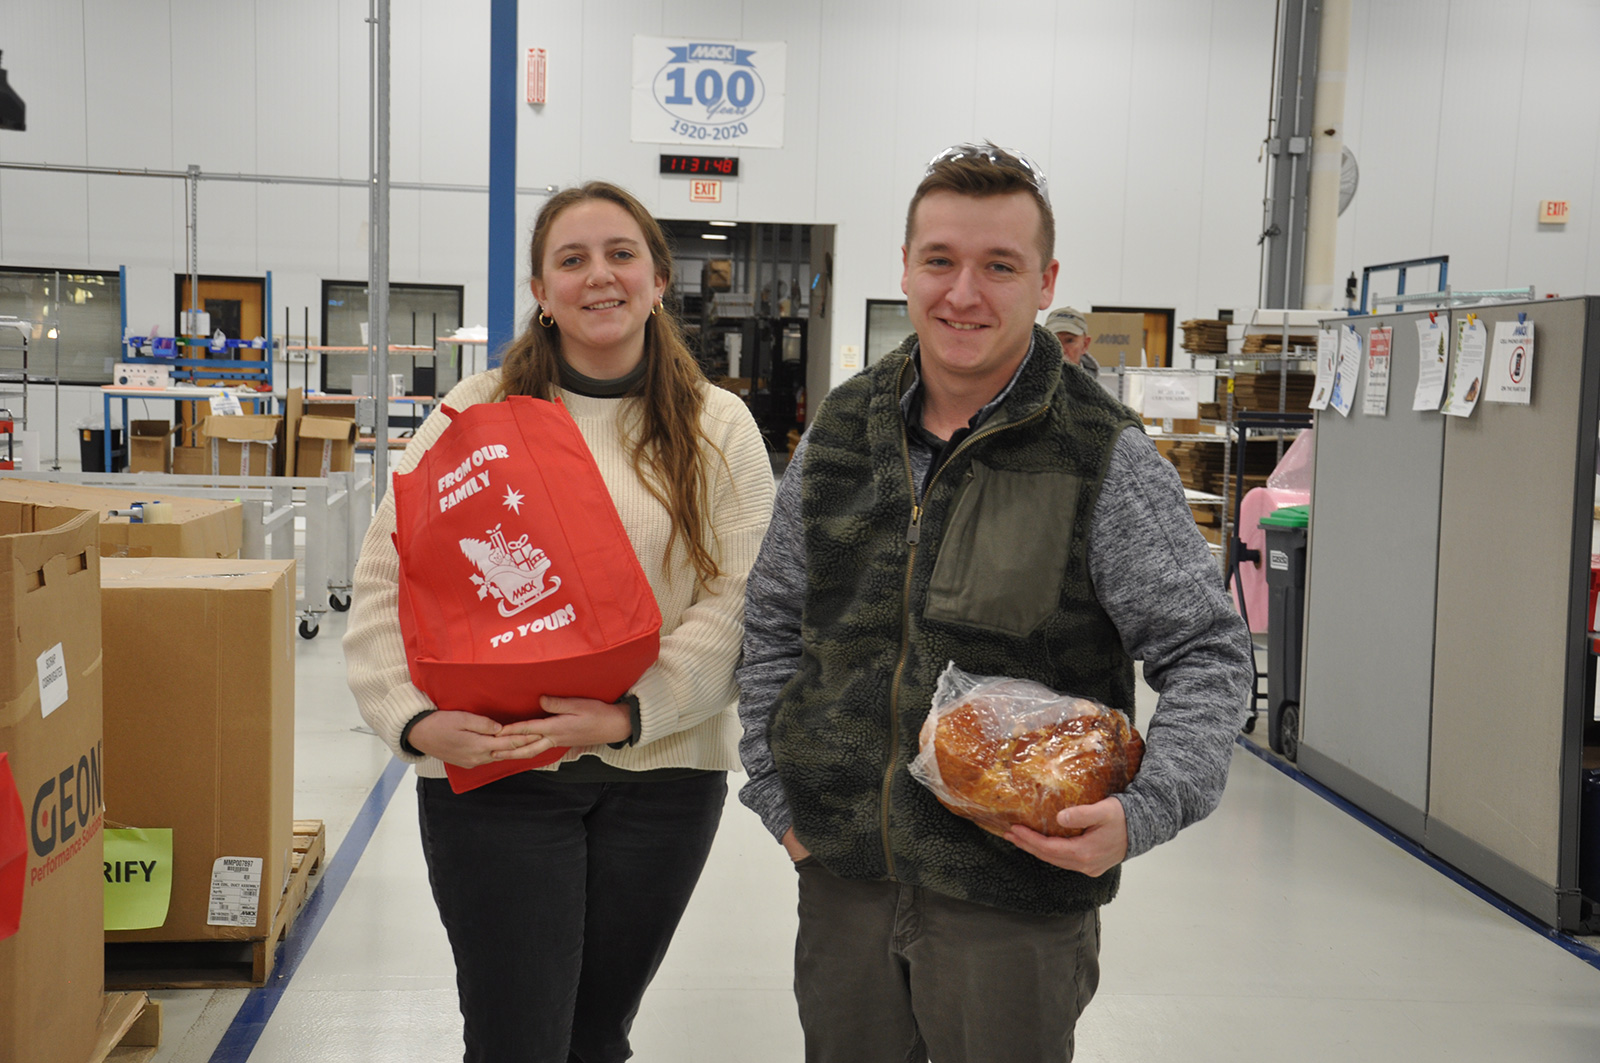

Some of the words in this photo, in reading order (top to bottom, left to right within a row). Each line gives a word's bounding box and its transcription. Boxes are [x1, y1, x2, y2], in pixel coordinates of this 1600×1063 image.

[691, 45, 733, 60] MACK
[664, 67, 755, 109] 100
[705, 98, 747, 120] Years
[670, 120, 748, 140] 1920-2020
[694, 182, 717, 196] EXIT
[1547, 201, 1566, 216] EXIT
[1094, 333, 1130, 345] MACK
[437, 457, 472, 494] FROM
[471, 444, 510, 467] OUR
[438, 470, 491, 513] FAMILY
[512, 580, 537, 602] MACK
[490, 631, 514, 648] TO
[517, 603, 577, 637] YOURS
[31, 739, 102, 858] GEON
[30, 836, 82, 887] Performance
[82, 812, 102, 848] Solutions
